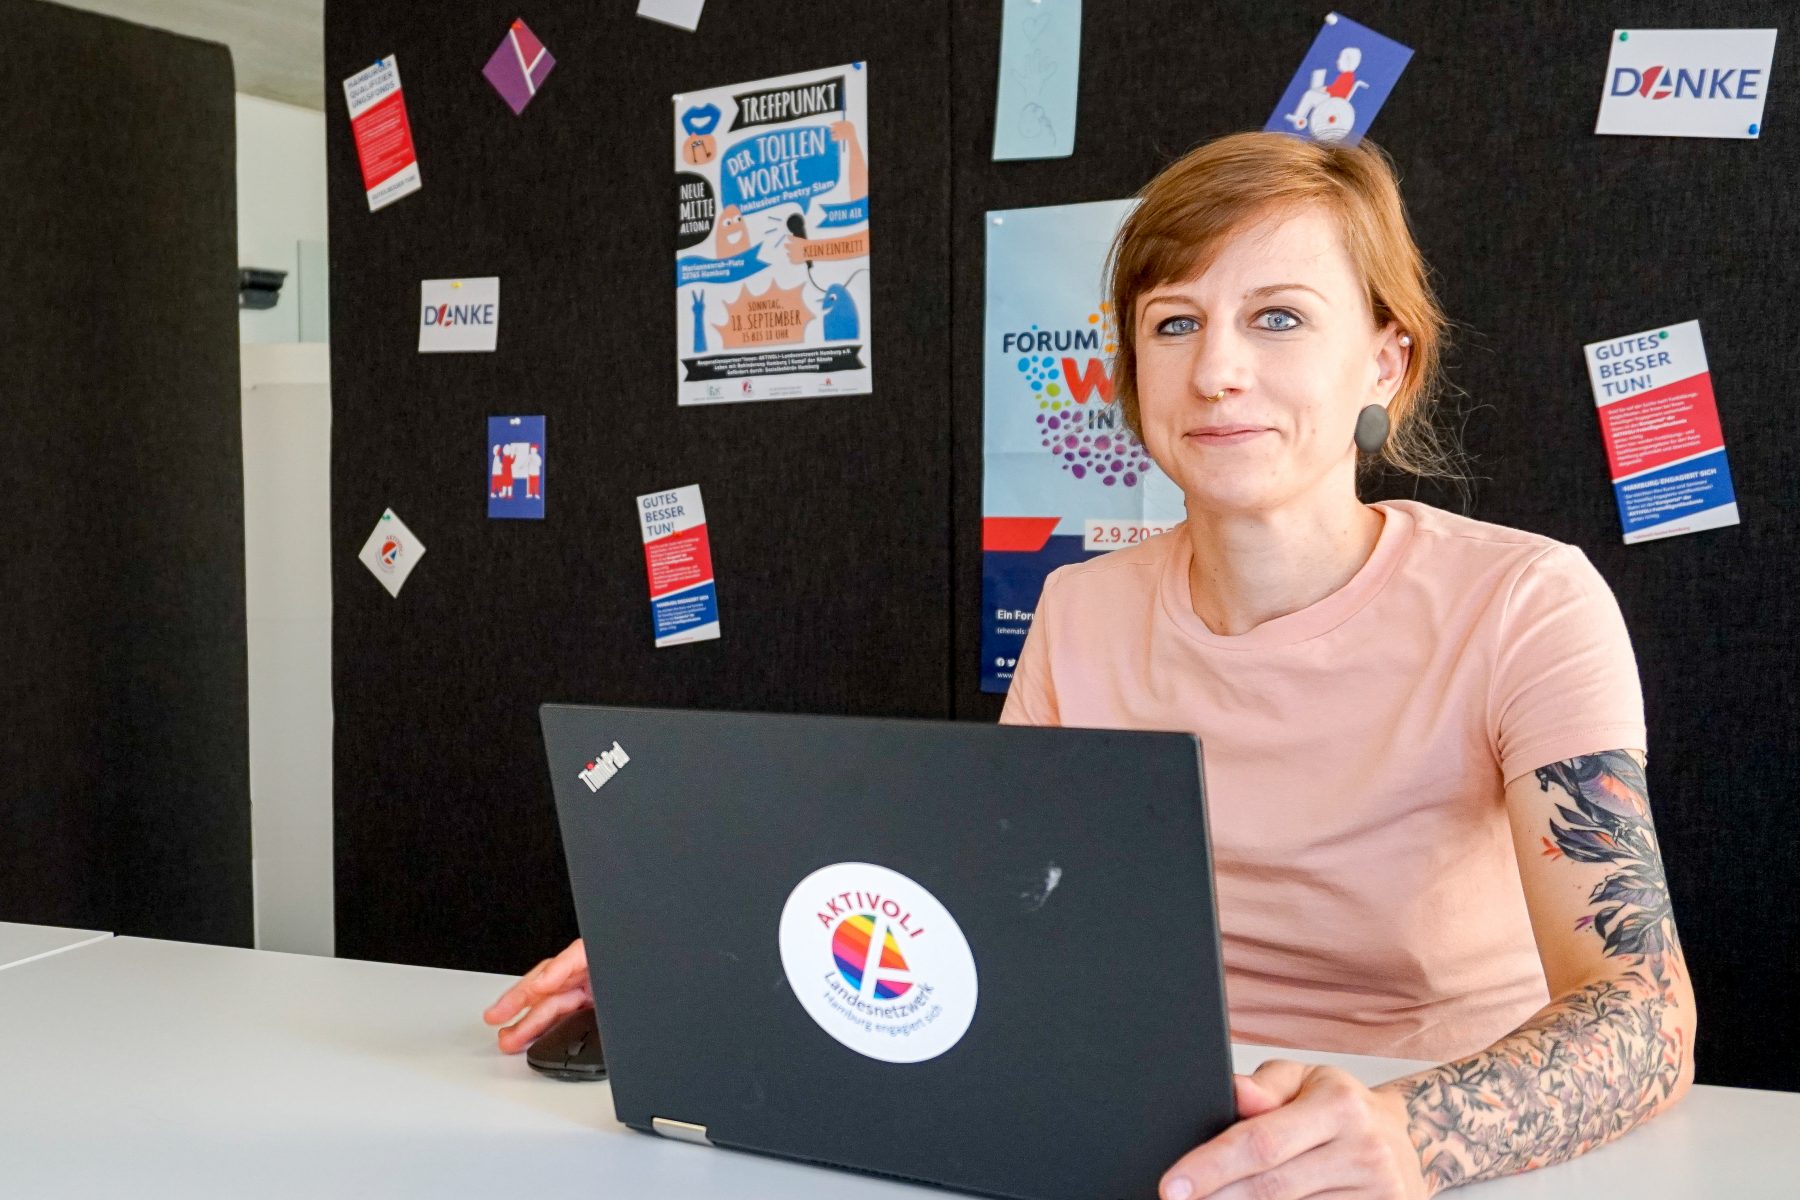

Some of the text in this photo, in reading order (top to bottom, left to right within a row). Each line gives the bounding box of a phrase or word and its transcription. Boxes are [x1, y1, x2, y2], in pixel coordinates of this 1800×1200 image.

[1610, 65, 1762, 101] DANKE
[741, 82, 838, 124] TREFFPUNKT
[726, 127, 826, 177] DER TOLLEN
[680, 182, 705, 200] NEUE
[737, 160, 802, 200] WORTE
[739, 179, 836, 213] Inklusiver Poetry Slam
[680, 199, 715, 220] MITTE
[828, 207, 863, 222] OPEN AIR
[680, 221, 710, 234] ALTONA
[803, 240, 864, 257] KEIN EINTRITT
[424, 303, 494, 327] DANKE
[731, 310, 802, 332] 18. SEPTEMBER
[742, 329, 790, 343] 15 BIS 18 UHR
[1003, 329, 1099, 353] FORUM
[1595, 333, 1661, 361] GUTES
[1599, 351, 1672, 379] BESSER
[1602, 374, 1652, 397] TUN!
[1089, 409, 1115, 430] IN
[643, 492, 678, 509] GUTES
[645, 505, 685, 523] BESSER
[647, 521, 676, 537] TUN!
[1093, 526, 1175, 544] 2.9.20
[997, 609, 1013, 620] Ein
[816, 891, 925, 939] AKTIVOLI
[824, 970, 936, 1020] Landesnetzwerk
[823, 991, 874, 1033] Hamburg
[926, 1003, 944, 1025] sich
